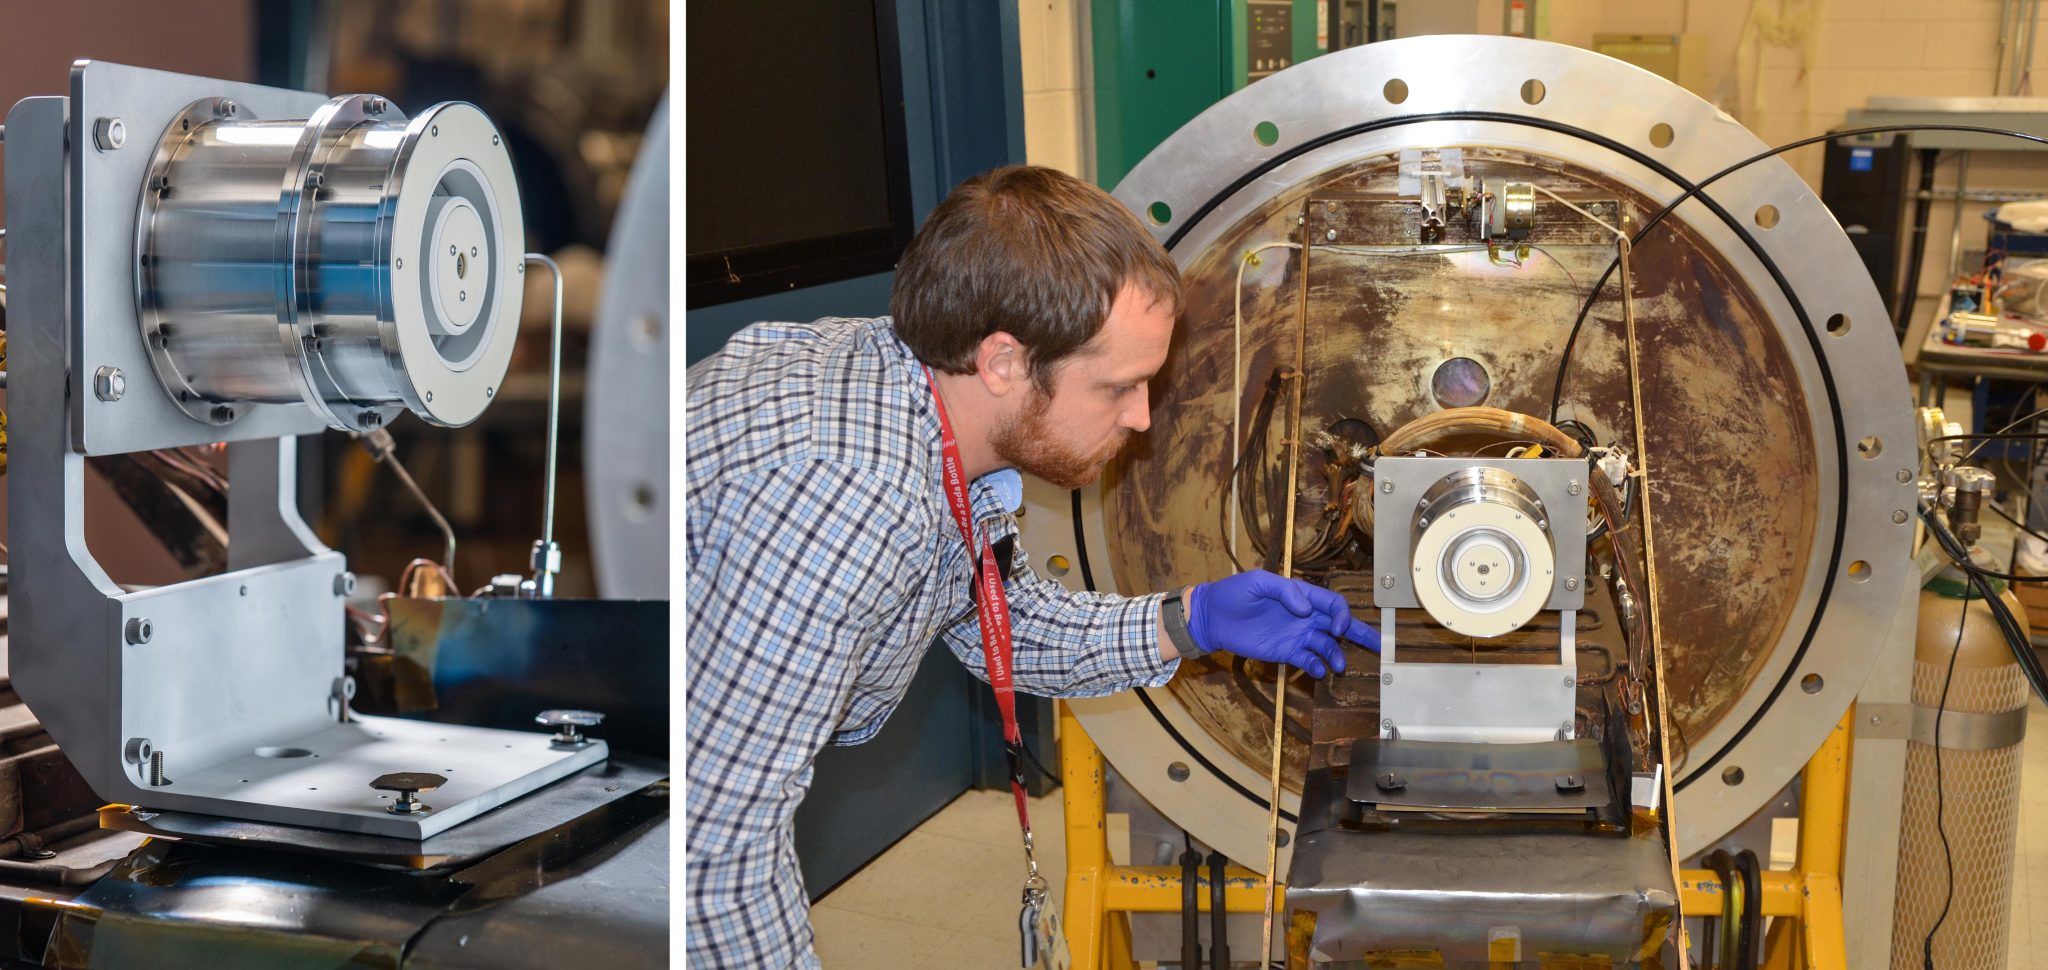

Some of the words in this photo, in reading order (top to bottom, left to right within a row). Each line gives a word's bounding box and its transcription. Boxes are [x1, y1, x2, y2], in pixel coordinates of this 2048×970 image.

[946, 457, 959, 485] Bottle
[953, 486, 965, 509] Soda
[961, 517, 968, 528] Be
[989, 578, 1000, 601] Used
[984, 607, 993, 629] Soda
[992, 602, 1000, 613] to
[989, 634, 998, 647] Be
[992, 645, 1000, 656] to
[992, 655, 1005, 677] Used
